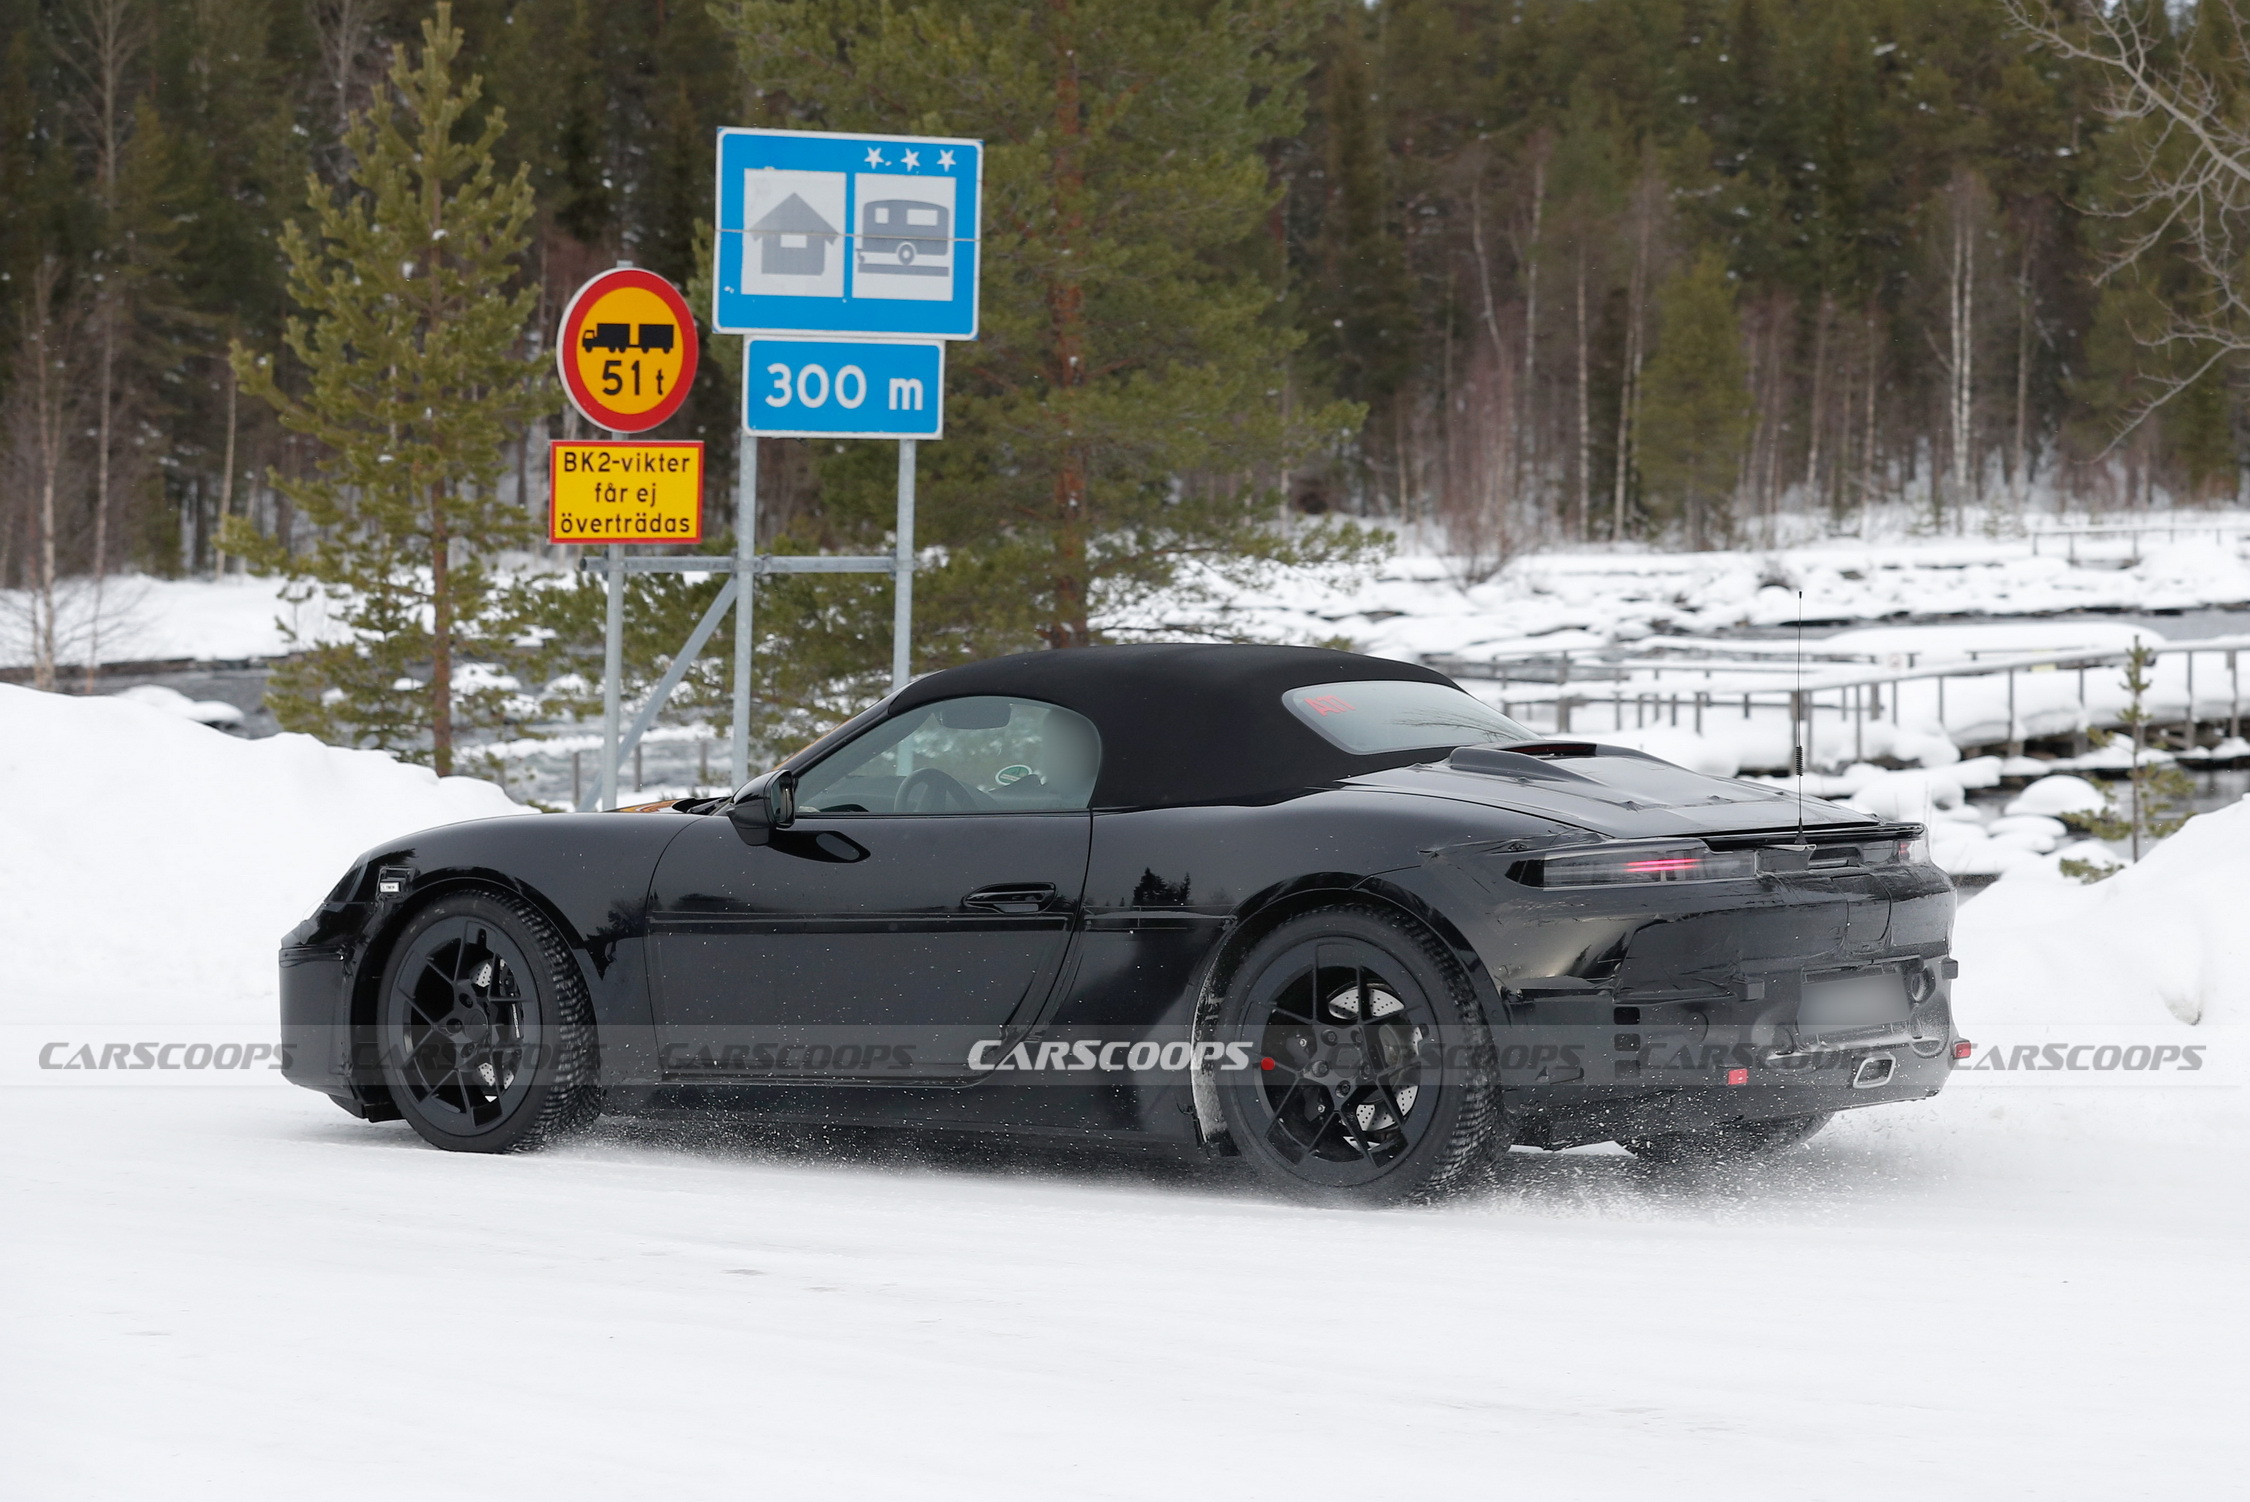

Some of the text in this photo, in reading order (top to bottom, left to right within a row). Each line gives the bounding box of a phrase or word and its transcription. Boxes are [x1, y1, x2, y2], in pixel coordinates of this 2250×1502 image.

[602, 360, 664, 396] 51 t
[765, 362, 924, 411] 300 m
[564, 452, 690, 472] BK2-vikter
[595, 482, 656, 508] får ej
[561, 512, 690, 533] överträdas
